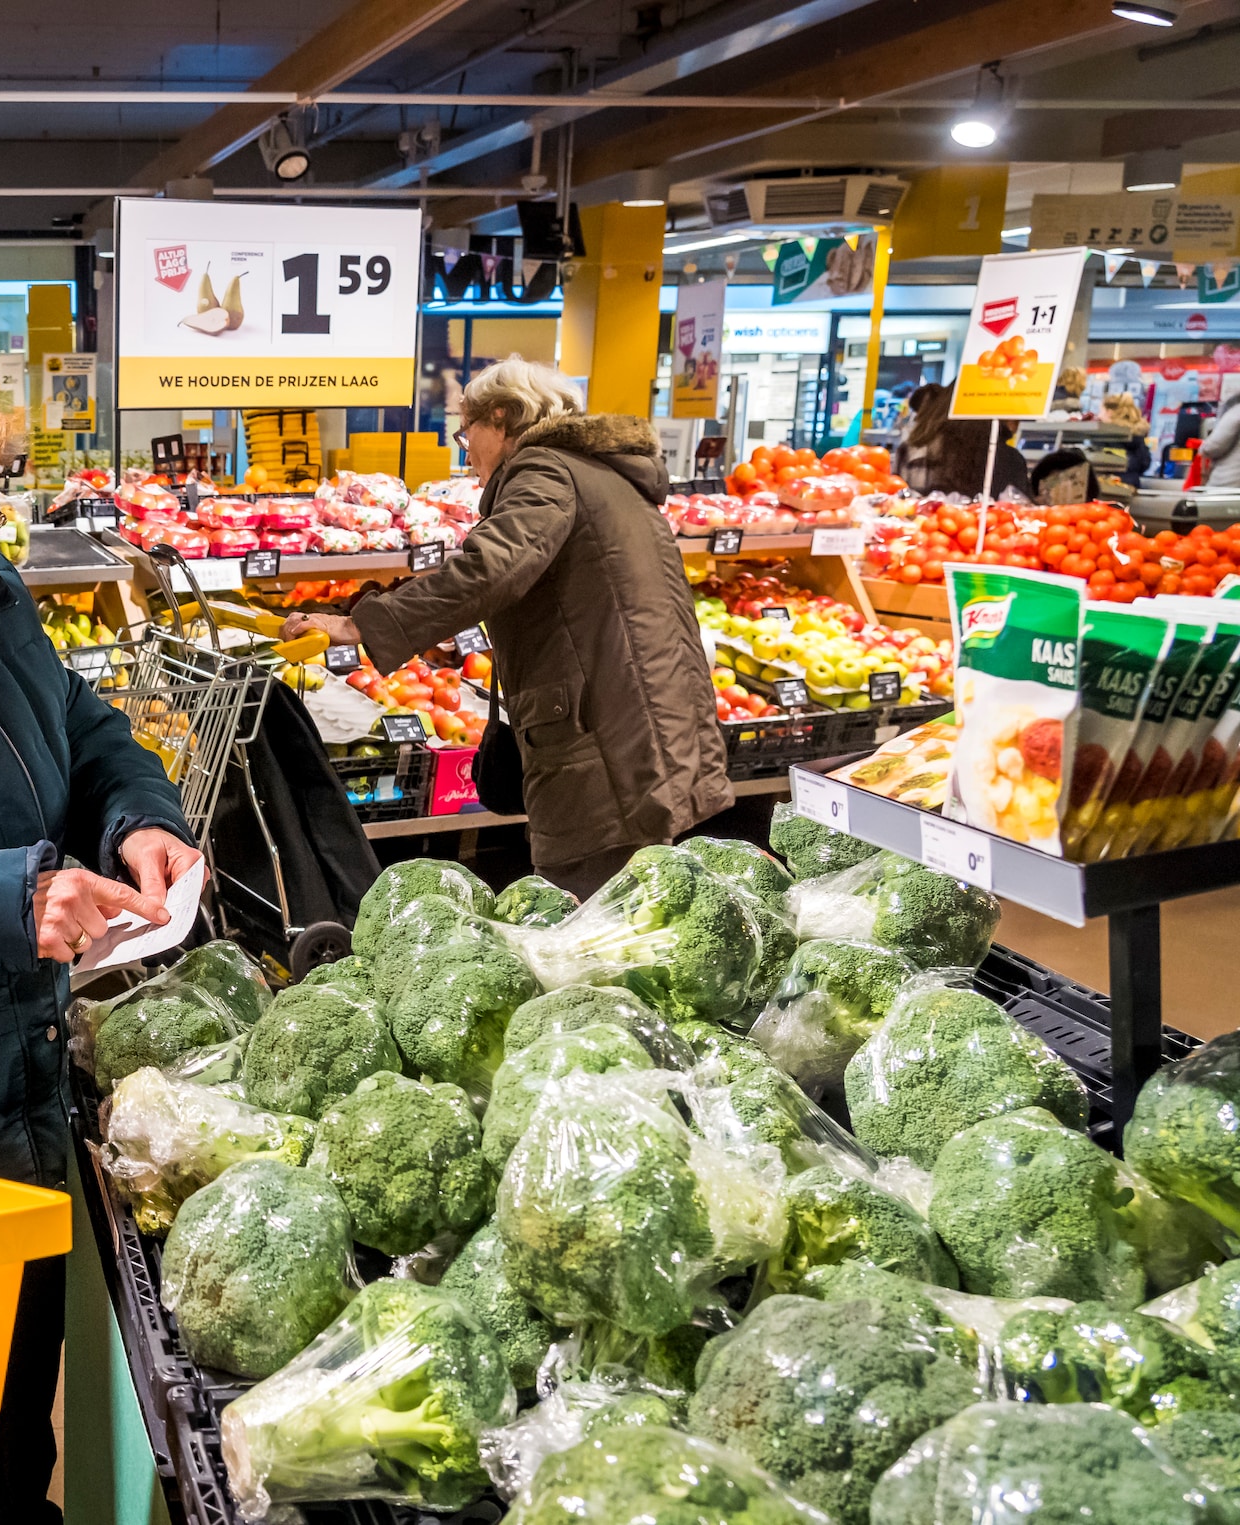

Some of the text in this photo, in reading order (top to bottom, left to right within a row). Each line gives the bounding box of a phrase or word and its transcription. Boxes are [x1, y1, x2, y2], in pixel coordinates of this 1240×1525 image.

[281, 253, 391, 334] 1 59
[1030, 304, 1058, 326] 1+1
[734, 325, 819, 339] wish opticiens
[159, 375, 379, 387] WE HOUDEN DE PRIJZEN LAAG
[1031, 638, 1076, 668] KAAS
[1047, 667, 1075, 686] SAUS
[1097, 666, 1144, 696] KAAS
